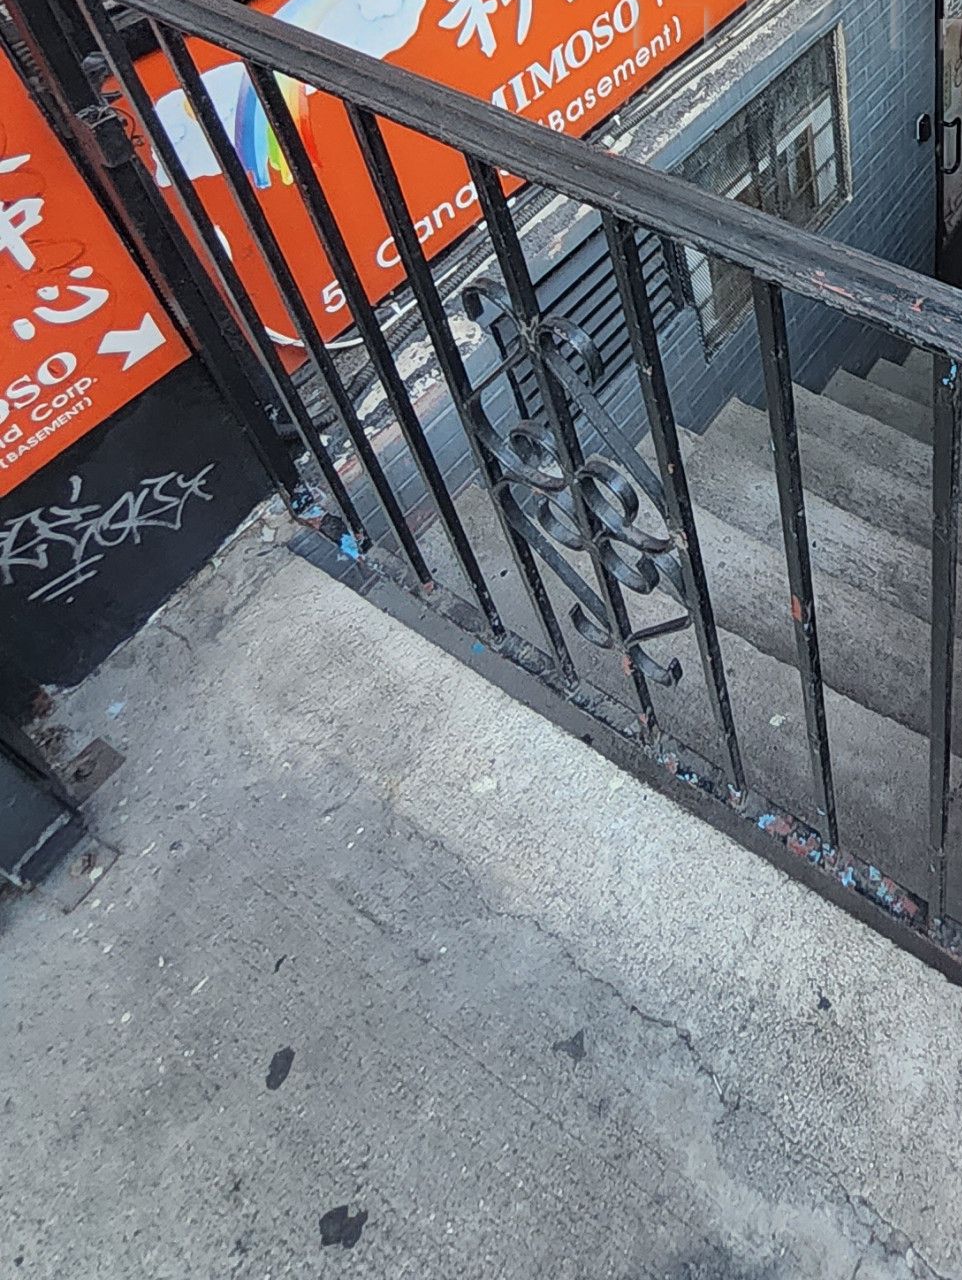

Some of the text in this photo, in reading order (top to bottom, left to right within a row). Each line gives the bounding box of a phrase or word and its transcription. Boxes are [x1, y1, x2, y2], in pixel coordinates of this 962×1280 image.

[538, 15, 682, 135] Basement)
[375, 179, 482, 269] Cana
[0, 398, 93, 470] (BASEMENT)
[30, 375, 99, 422] Corp.
